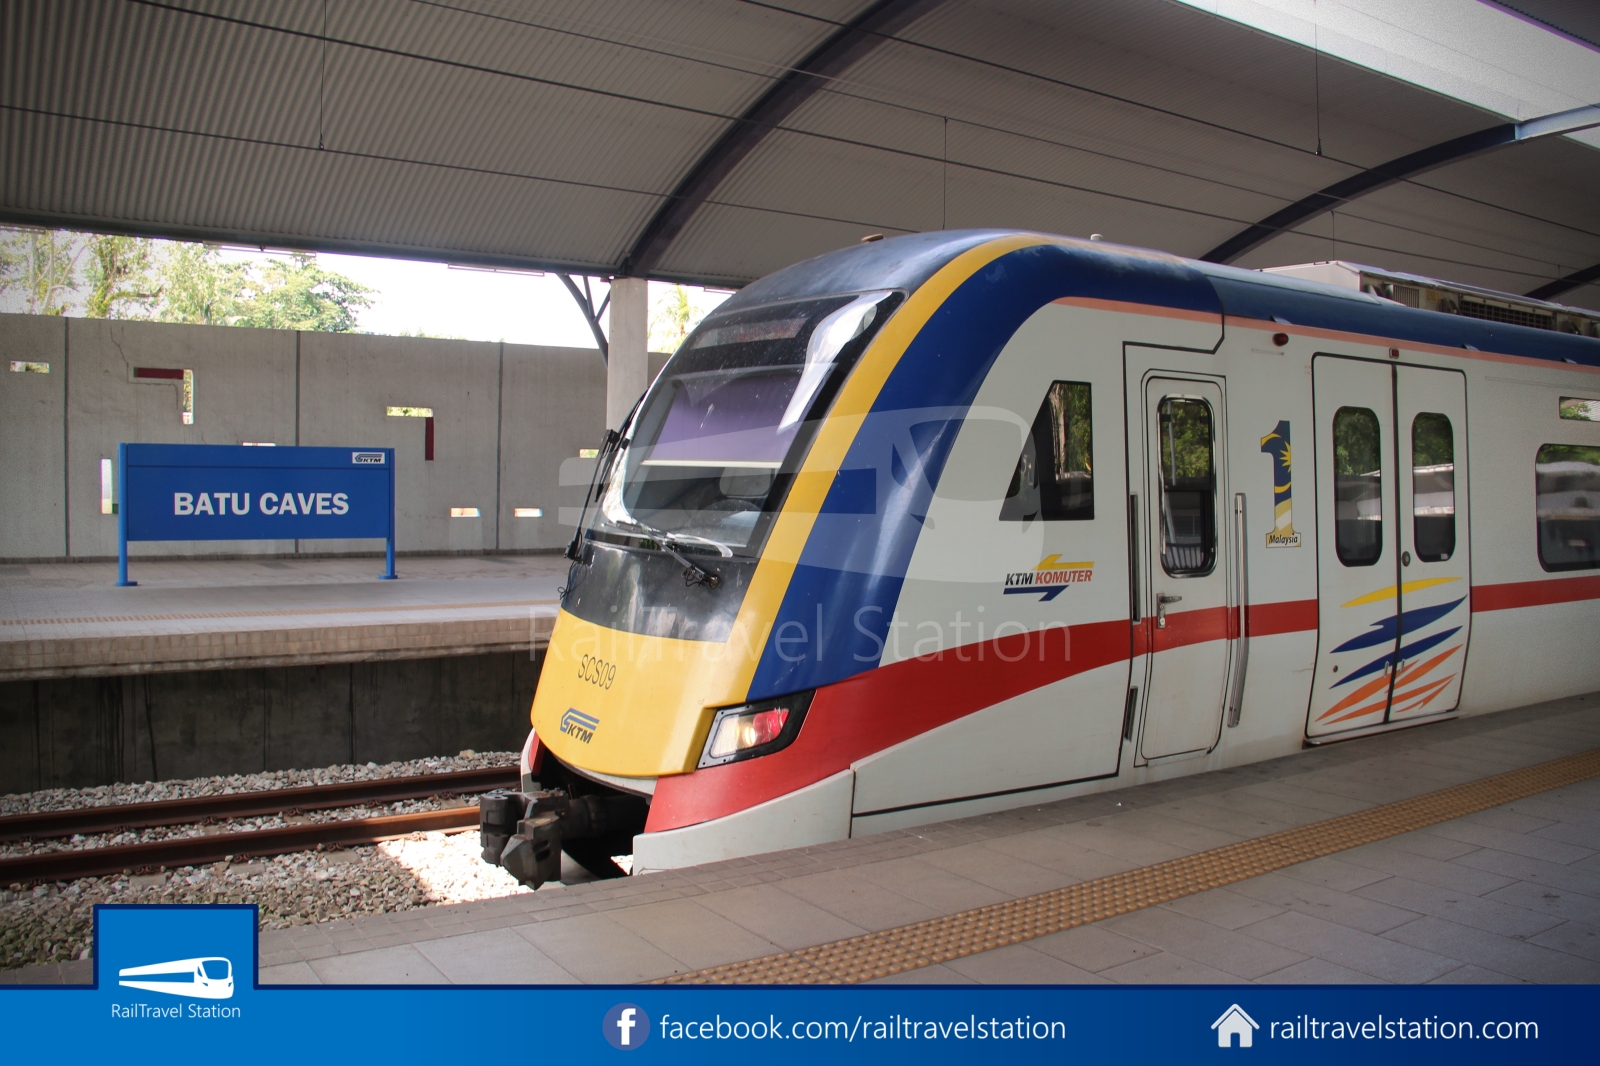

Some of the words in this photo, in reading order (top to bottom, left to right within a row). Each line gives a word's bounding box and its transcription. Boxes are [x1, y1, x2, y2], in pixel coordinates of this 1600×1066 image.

[174, 492, 250, 515] BATU
[259, 492, 349, 515] CAVES
[1268, 532, 1298, 546] Malaysia
[1005, 572, 1033, 586] KTM
[1034, 570, 1093, 584] KOMUTER
[577, 653, 617, 690] SCS09
[567, 723, 593, 743] KTM
